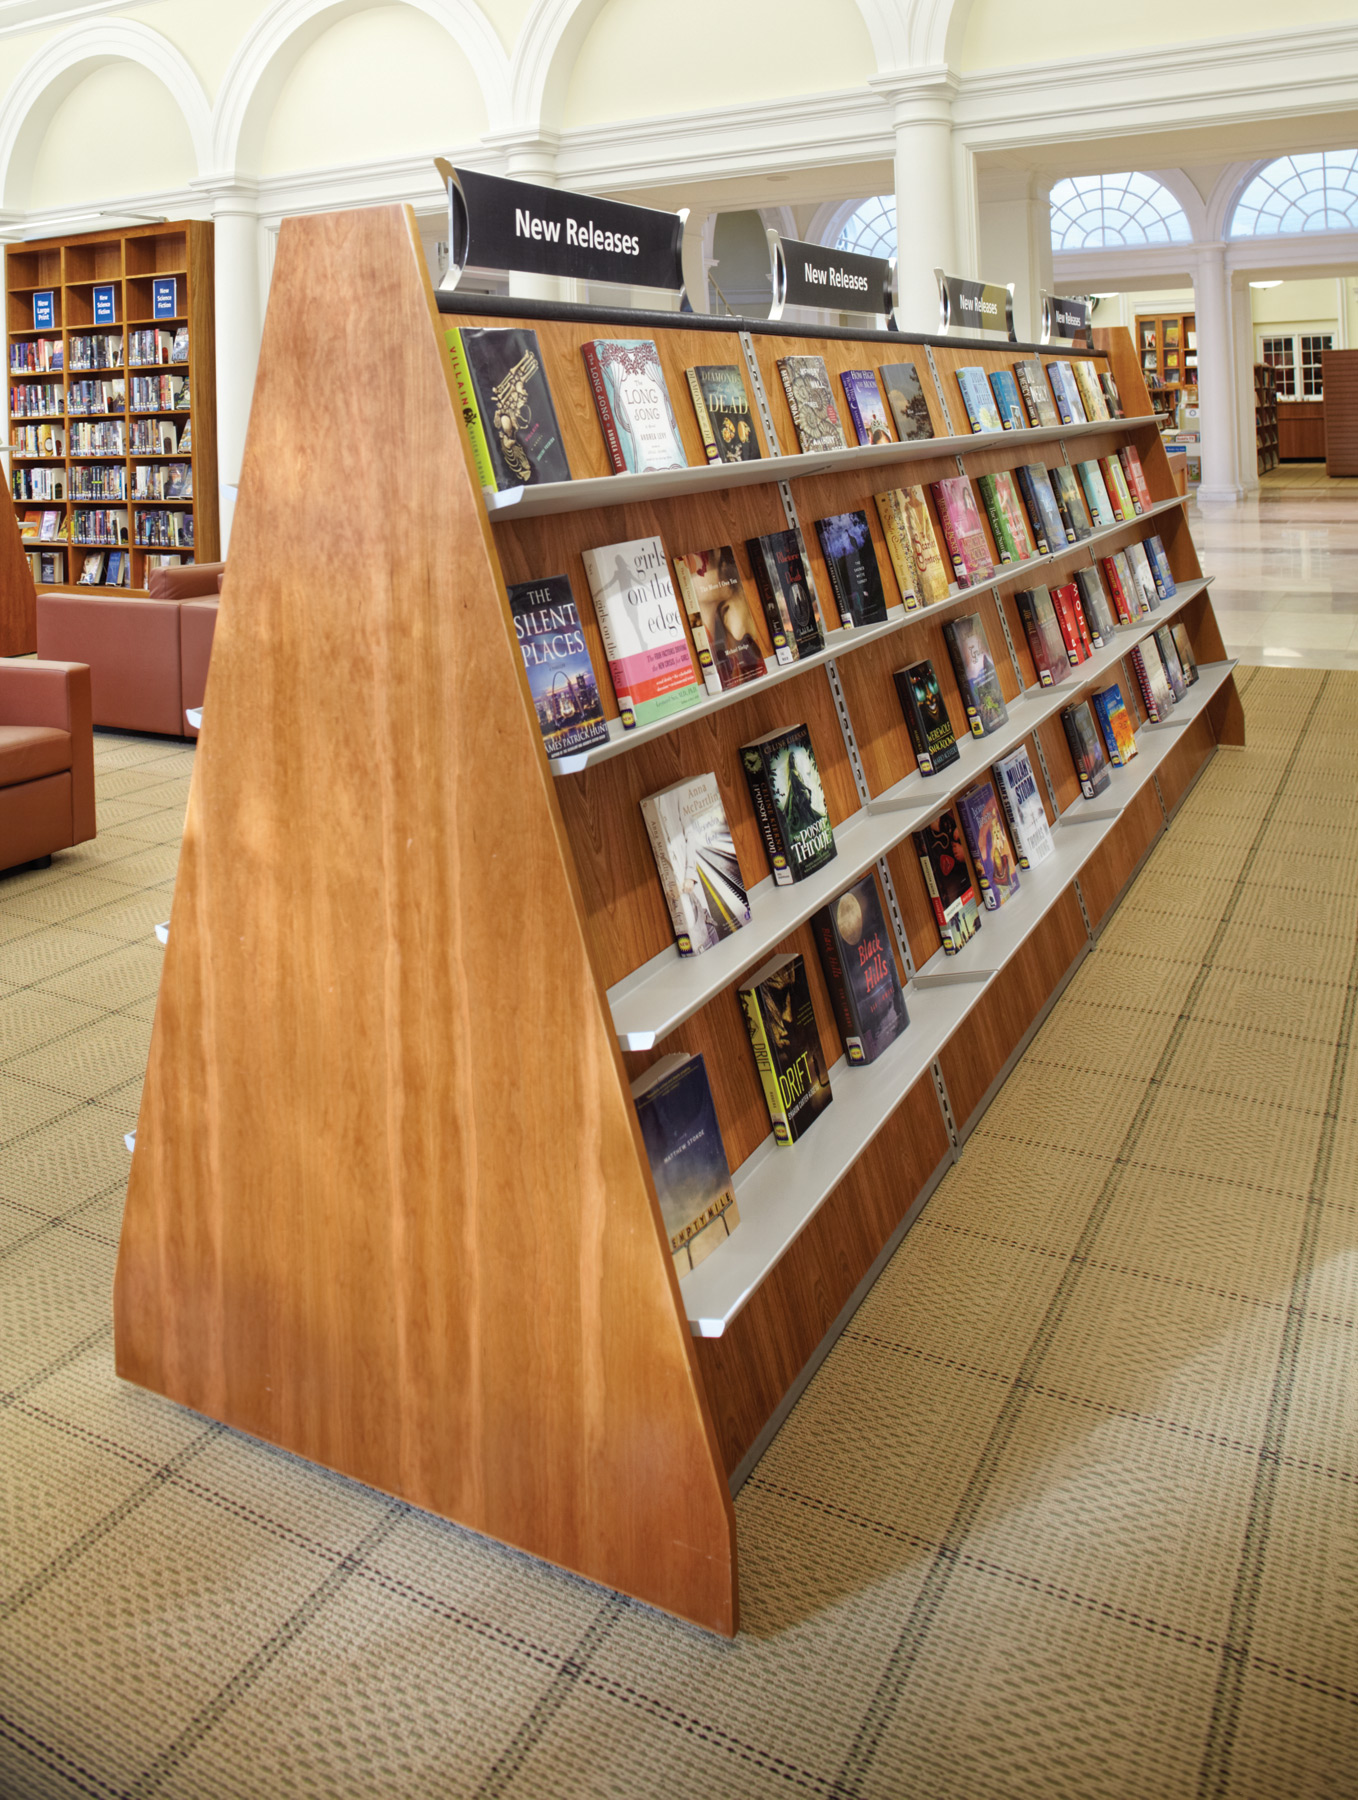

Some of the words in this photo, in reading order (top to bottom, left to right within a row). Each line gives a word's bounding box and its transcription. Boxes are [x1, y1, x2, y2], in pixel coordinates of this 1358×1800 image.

[515, 208, 561, 243] New
[566, 217, 640, 256] Releases
[804, 262, 827, 285] New
[828, 267, 868, 292] Releases
[37, 307, 50, 315] Large
[959, 294, 974, 311] New
[974, 296, 998, 315] Releases
[1055, 310, 1065, 324] New
[1065, 311, 1081, 327] Releases
[450, 346, 469, 406] VILLAIN
[701, 371, 742, 382] DIAMONDS
[1016, 368, 1024, 377] NO
[1019, 377, 1031, 399] MERCY
[590, 367, 601, 393] LONG
[598, 395, 610, 421] SONG
[624, 388, 659, 405] LONG
[687, 369, 704, 414] DIAMONDS
[708, 393, 749, 415] DEAD
[780, 369, 794, 401] MEMORY
[789, 401, 801, 425] WALL
[634, 408, 660, 421] SONG
[607, 429, 618, 453] ANDREA
[613, 452, 622, 468] LEVY
[633, 541, 667, 580] girls
[527, 587, 552, 605] THE
[627, 588, 648, 607] on
[649, 573, 675, 600] the
[513, 602, 576, 639] SILENT
[594, 595, 607, 626] girls
[647, 604, 682, 638] edge
[1023, 609, 1031, 619] JOE
[602, 625, 612, 639] on
[1026, 621, 1036, 634] HILL
[520, 630, 585, 667] PLACES
[606, 640, 616, 661] the
[611, 661, 624, 688] edge
[562, 731, 590, 747] PATRICK
[590, 723, 608, 737] HUNT
[927, 721, 951, 742] WEREWOLF
[682, 793, 719, 817] McPartlin
[687, 783, 707, 799] Anna
[754, 787, 768, 819] POISON
[763, 824, 777, 854] THRON
[760, 782, 774, 814] CELINE
[770, 816, 783, 851] KIERNA
[1003, 800, 1015, 823] STORM
[651, 820, 659, 840] Anna
[657, 841, 669, 878] McPartlin
[821, 927, 835, 953] Black
[829, 956, 843, 979] Hills
[857, 932, 884, 967] Black
[864, 953, 888, 993] Hills
[753, 1042, 773, 1074] DRIFT
[778, 1050, 813, 1110] DRIFT
[663, 1143, 688, 1164] MATTHEW
[687, 1128, 706, 1148] STOKOE
[671, 1214, 706, 1249] EMPTY
[707, 1191, 733, 1220] MILE
